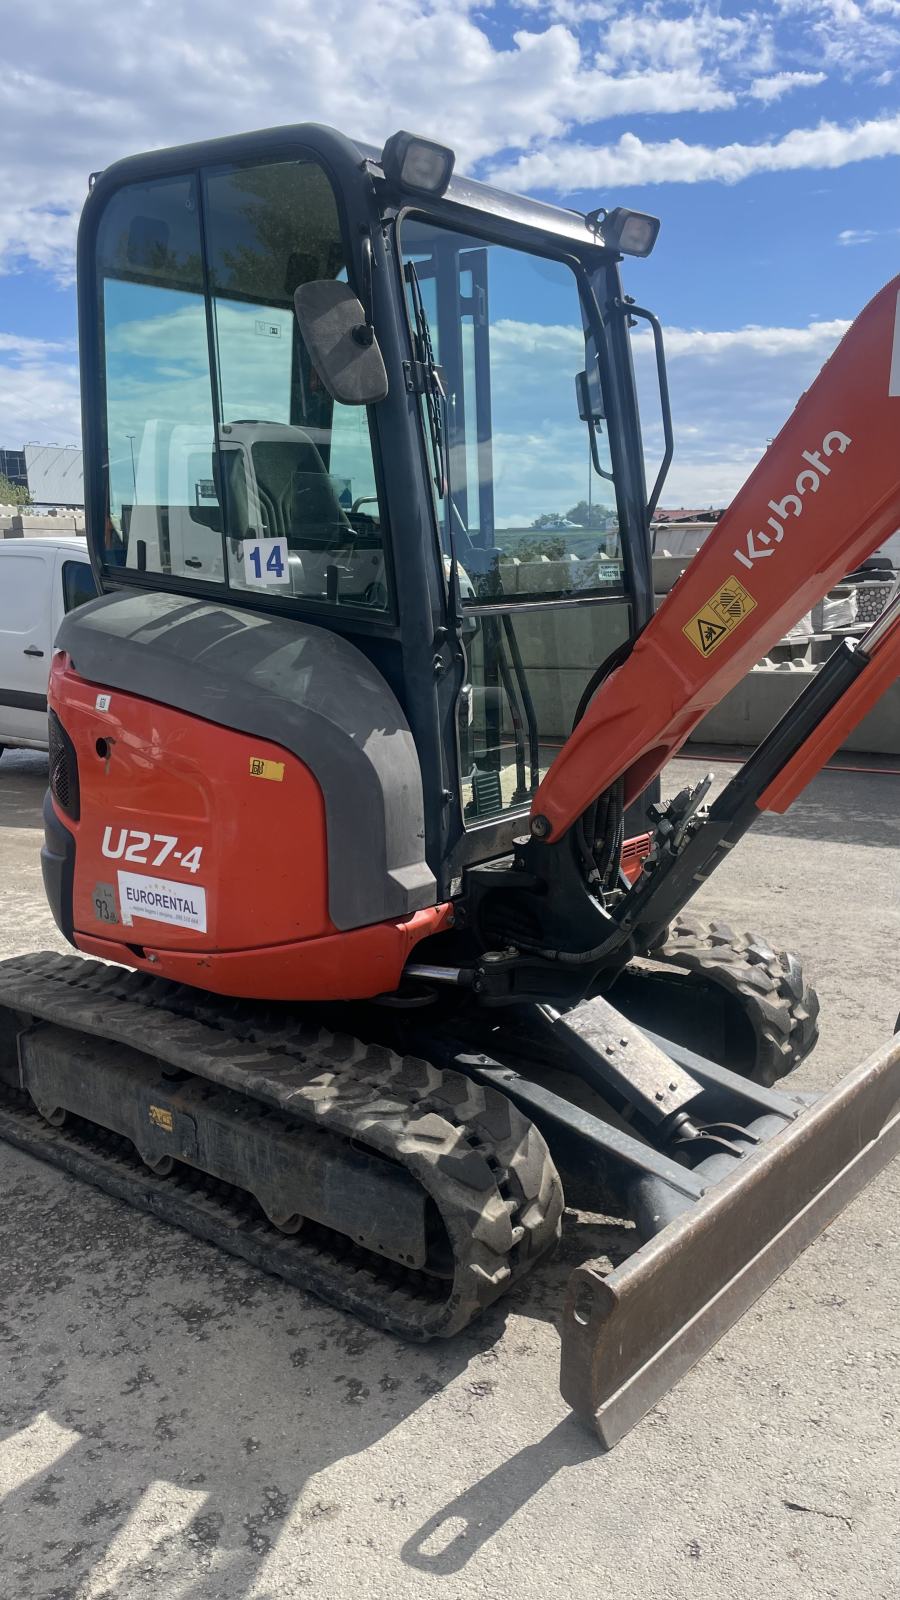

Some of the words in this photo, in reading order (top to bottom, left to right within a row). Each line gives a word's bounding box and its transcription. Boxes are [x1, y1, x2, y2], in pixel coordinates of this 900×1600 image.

[733, 430, 852, 569] Kubota
[250, 545, 284, 578] 14
[101, 826, 203, 873] U27-4
[126, 887, 198, 914] EURORENTAL
